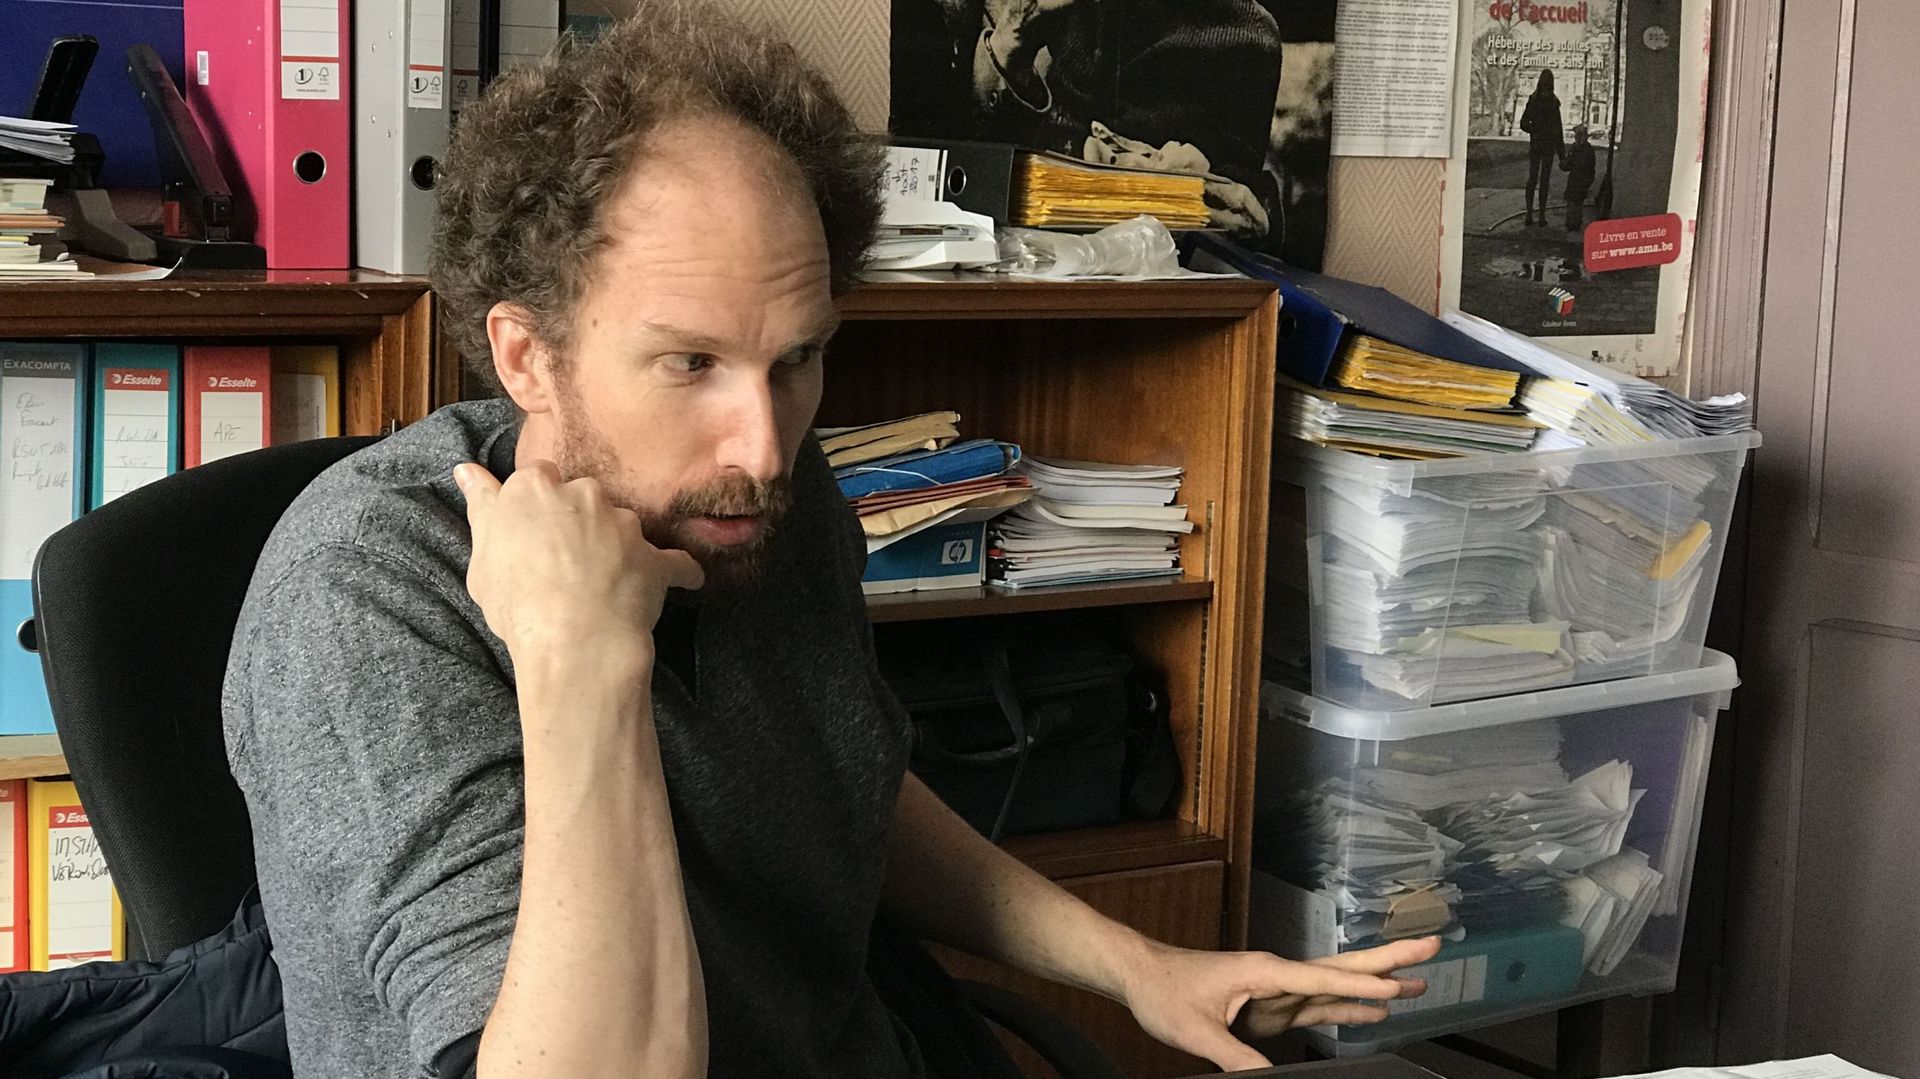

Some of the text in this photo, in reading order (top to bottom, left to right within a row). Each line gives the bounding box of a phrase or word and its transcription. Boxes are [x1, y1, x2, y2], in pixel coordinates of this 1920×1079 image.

[1489, 0, 1512, 21] de
[1488, 35, 1532, 52] Héberger
[1536, 40, 1552, 51] des
[1487, 56, 1498, 66] et
[1500, 53, 1518, 66] des
[1520, 53, 1559, 68] familles
[1599, 227, 1667, 244] Livre en vente
[1591, 241, 1674, 260] sur www.ama.be
[3, 359, 71, 371] EXACOMPTA
[122, 374, 162, 386] Esselte
[218, 377, 257, 388] Esselte
